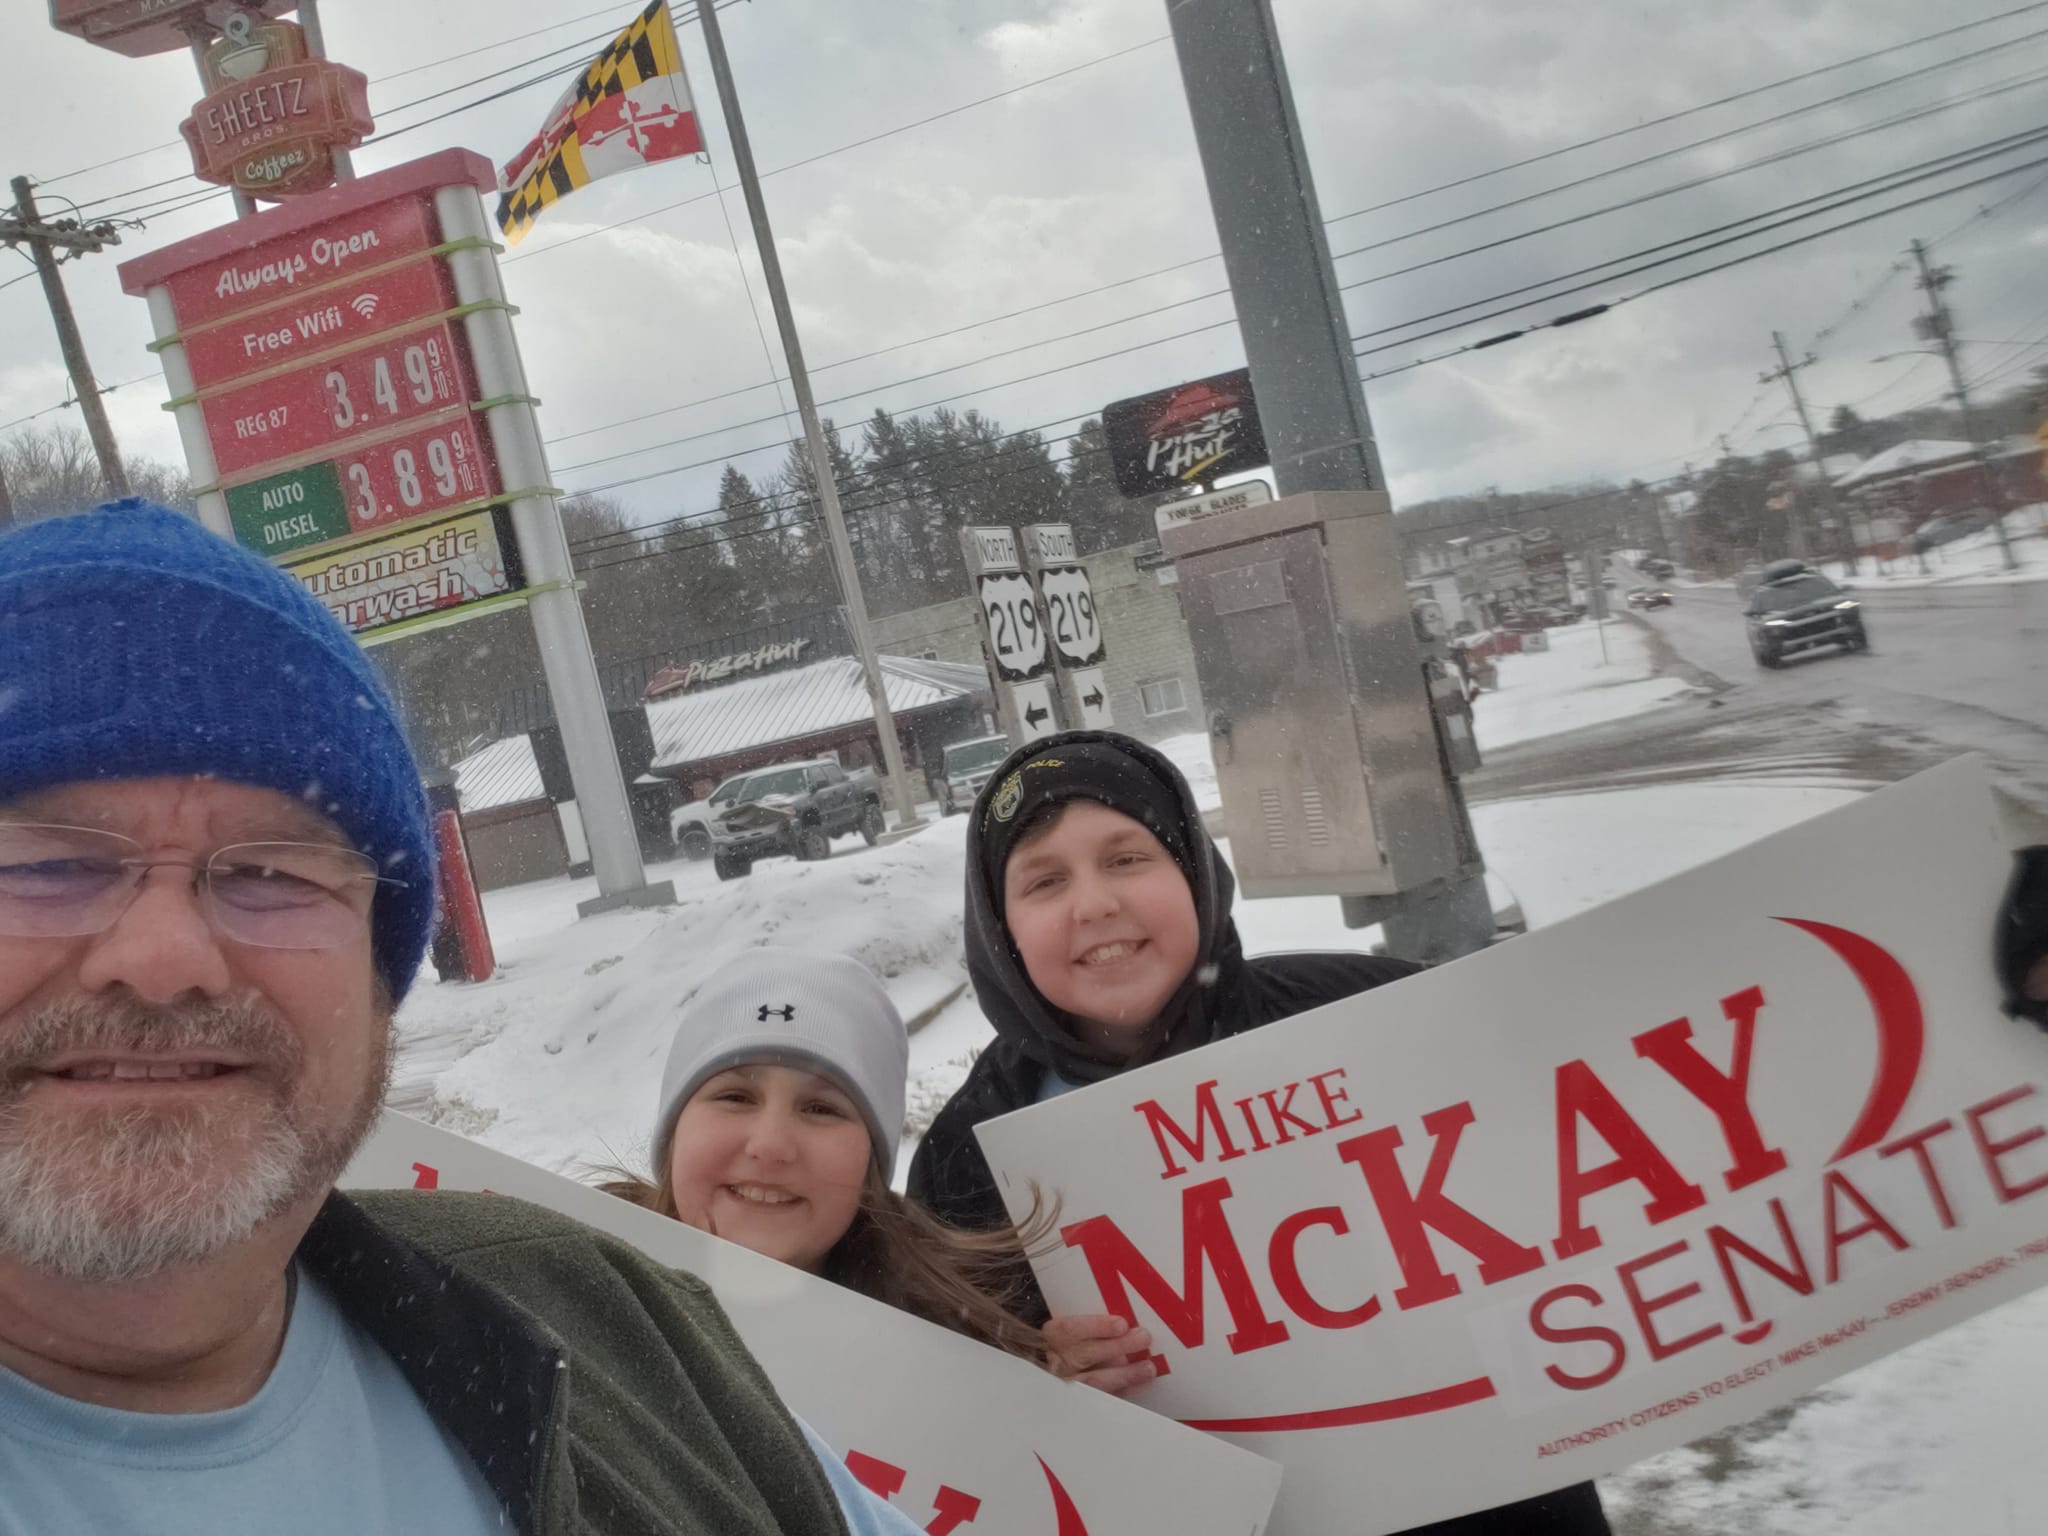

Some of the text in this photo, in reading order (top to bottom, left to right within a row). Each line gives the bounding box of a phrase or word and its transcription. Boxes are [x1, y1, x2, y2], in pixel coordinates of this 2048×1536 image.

[207, 78, 307, 145] SHEETZ
[245, 147, 305, 181] Coffeez
[216, 230, 380, 299] Always Open
[243, 306, 343, 357] Free Wifi
[234, 411, 267, 439] REG
[269, 406, 288, 429] 87
[1146, 407, 1243, 472] Pizza
[1165, 429, 1236, 477] Hut
[262, 481, 304, 512] AUTO
[263, 512, 319, 545] DIESEL
[976, 534, 1019, 564] NORTH
[1039, 531, 1075, 558] SOUTH
[291, 527, 478, 597] utomatic
[323, 567, 465, 625] arwash
[1050, 591, 1094, 644] 219
[990, 598, 1037, 656] 219
[1133, 1067, 1363, 1179] MIKE
[1060, 985, 1788, 1377] McKAY
[1530, 1083, 2048, 1389] SENATE
[1537, 1418, 1628, 1458] AUTHORITY
[1629, 1391, 1700, 1427] CITIZENS
[1700, 1381, 1723, 1400] TO
[1725, 1358, 1773, 1390] ELECT
[1778, 1341, 1818, 1367] MIKE
